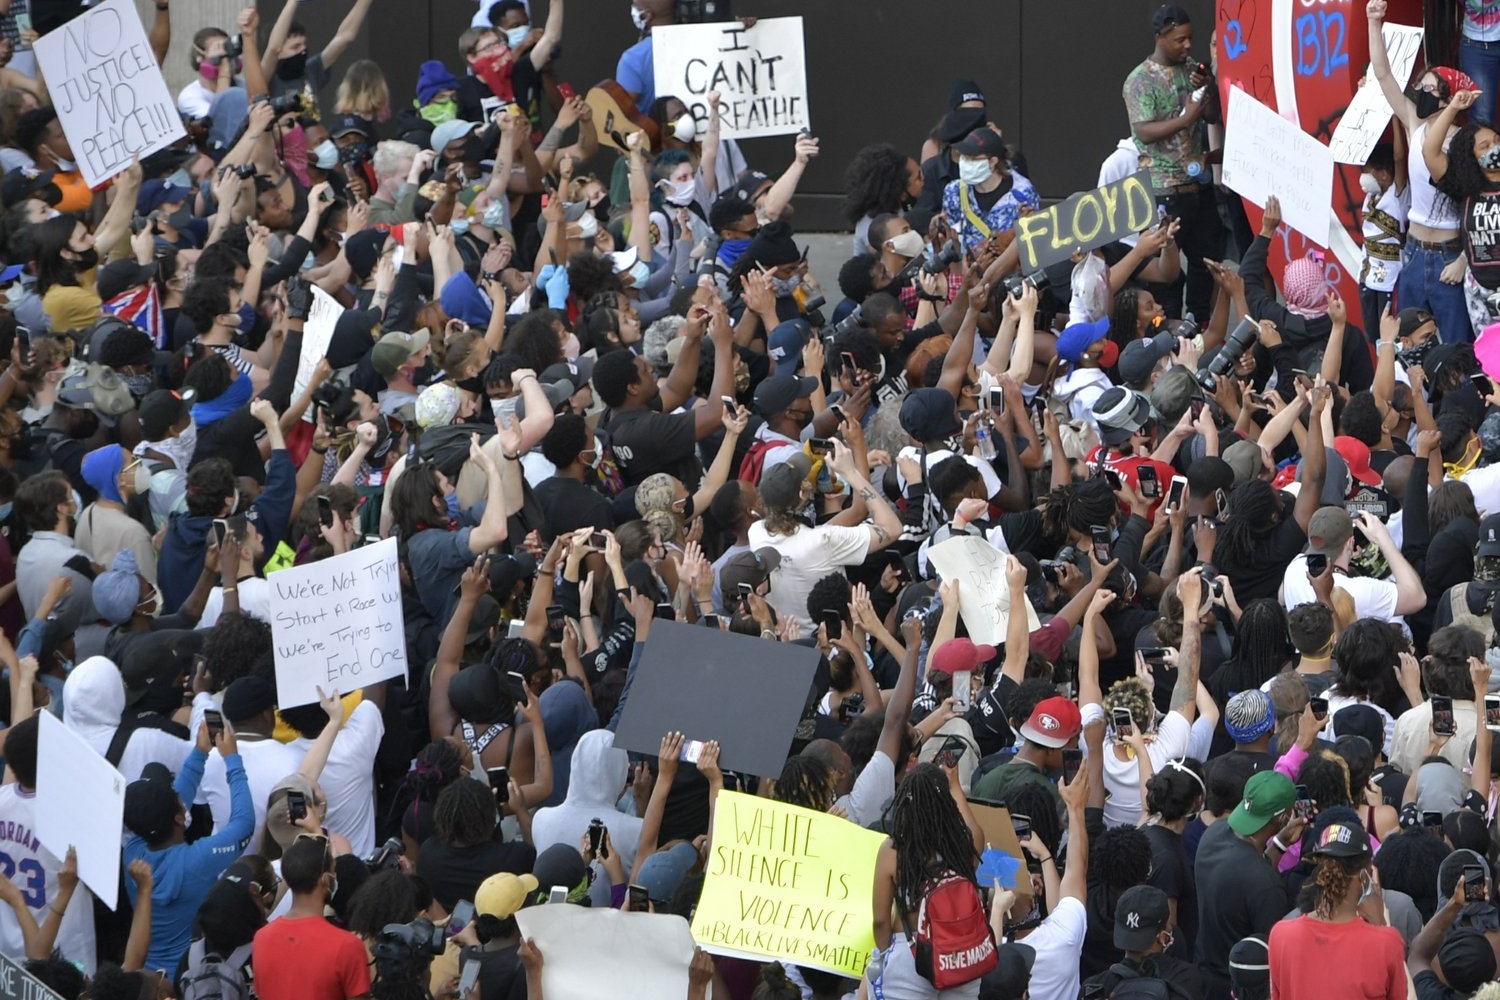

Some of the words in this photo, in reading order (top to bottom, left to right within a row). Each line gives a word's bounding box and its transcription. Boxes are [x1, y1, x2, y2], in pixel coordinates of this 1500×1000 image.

[64, 7, 122, 77] NO
[718, 28, 751, 52] I
[56, 42, 156, 114] JUSTICE!
[685, 49, 783, 95] CAN'T
[95, 82, 136, 132] NO
[690, 97, 803, 136] BREATHE
[82, 102, 174, 180] PEACE!!!
[1018, 176, 1154, 269] FLOYD
[332, 571, 358, 593] Not
[276, 608, 329, 631] Start
[335, 603, 345, 618] A
[349, 597, 378, 615] Race
[329, 625, 371, 647] Trying
[376, 616, 393, 633] to
[326, 646, 364, 684] End
[369, 646, 405, 669] One
[0, 820, 42, 854] ORDAN
[733, 802, 821, 858] WHITE
[711, 845, 804, 890] SILENCE
[825, 868, 851, 901] IS
[738, 890, 857, 937] VIOLENCE
[939, 950, 967, 972] STEVE
